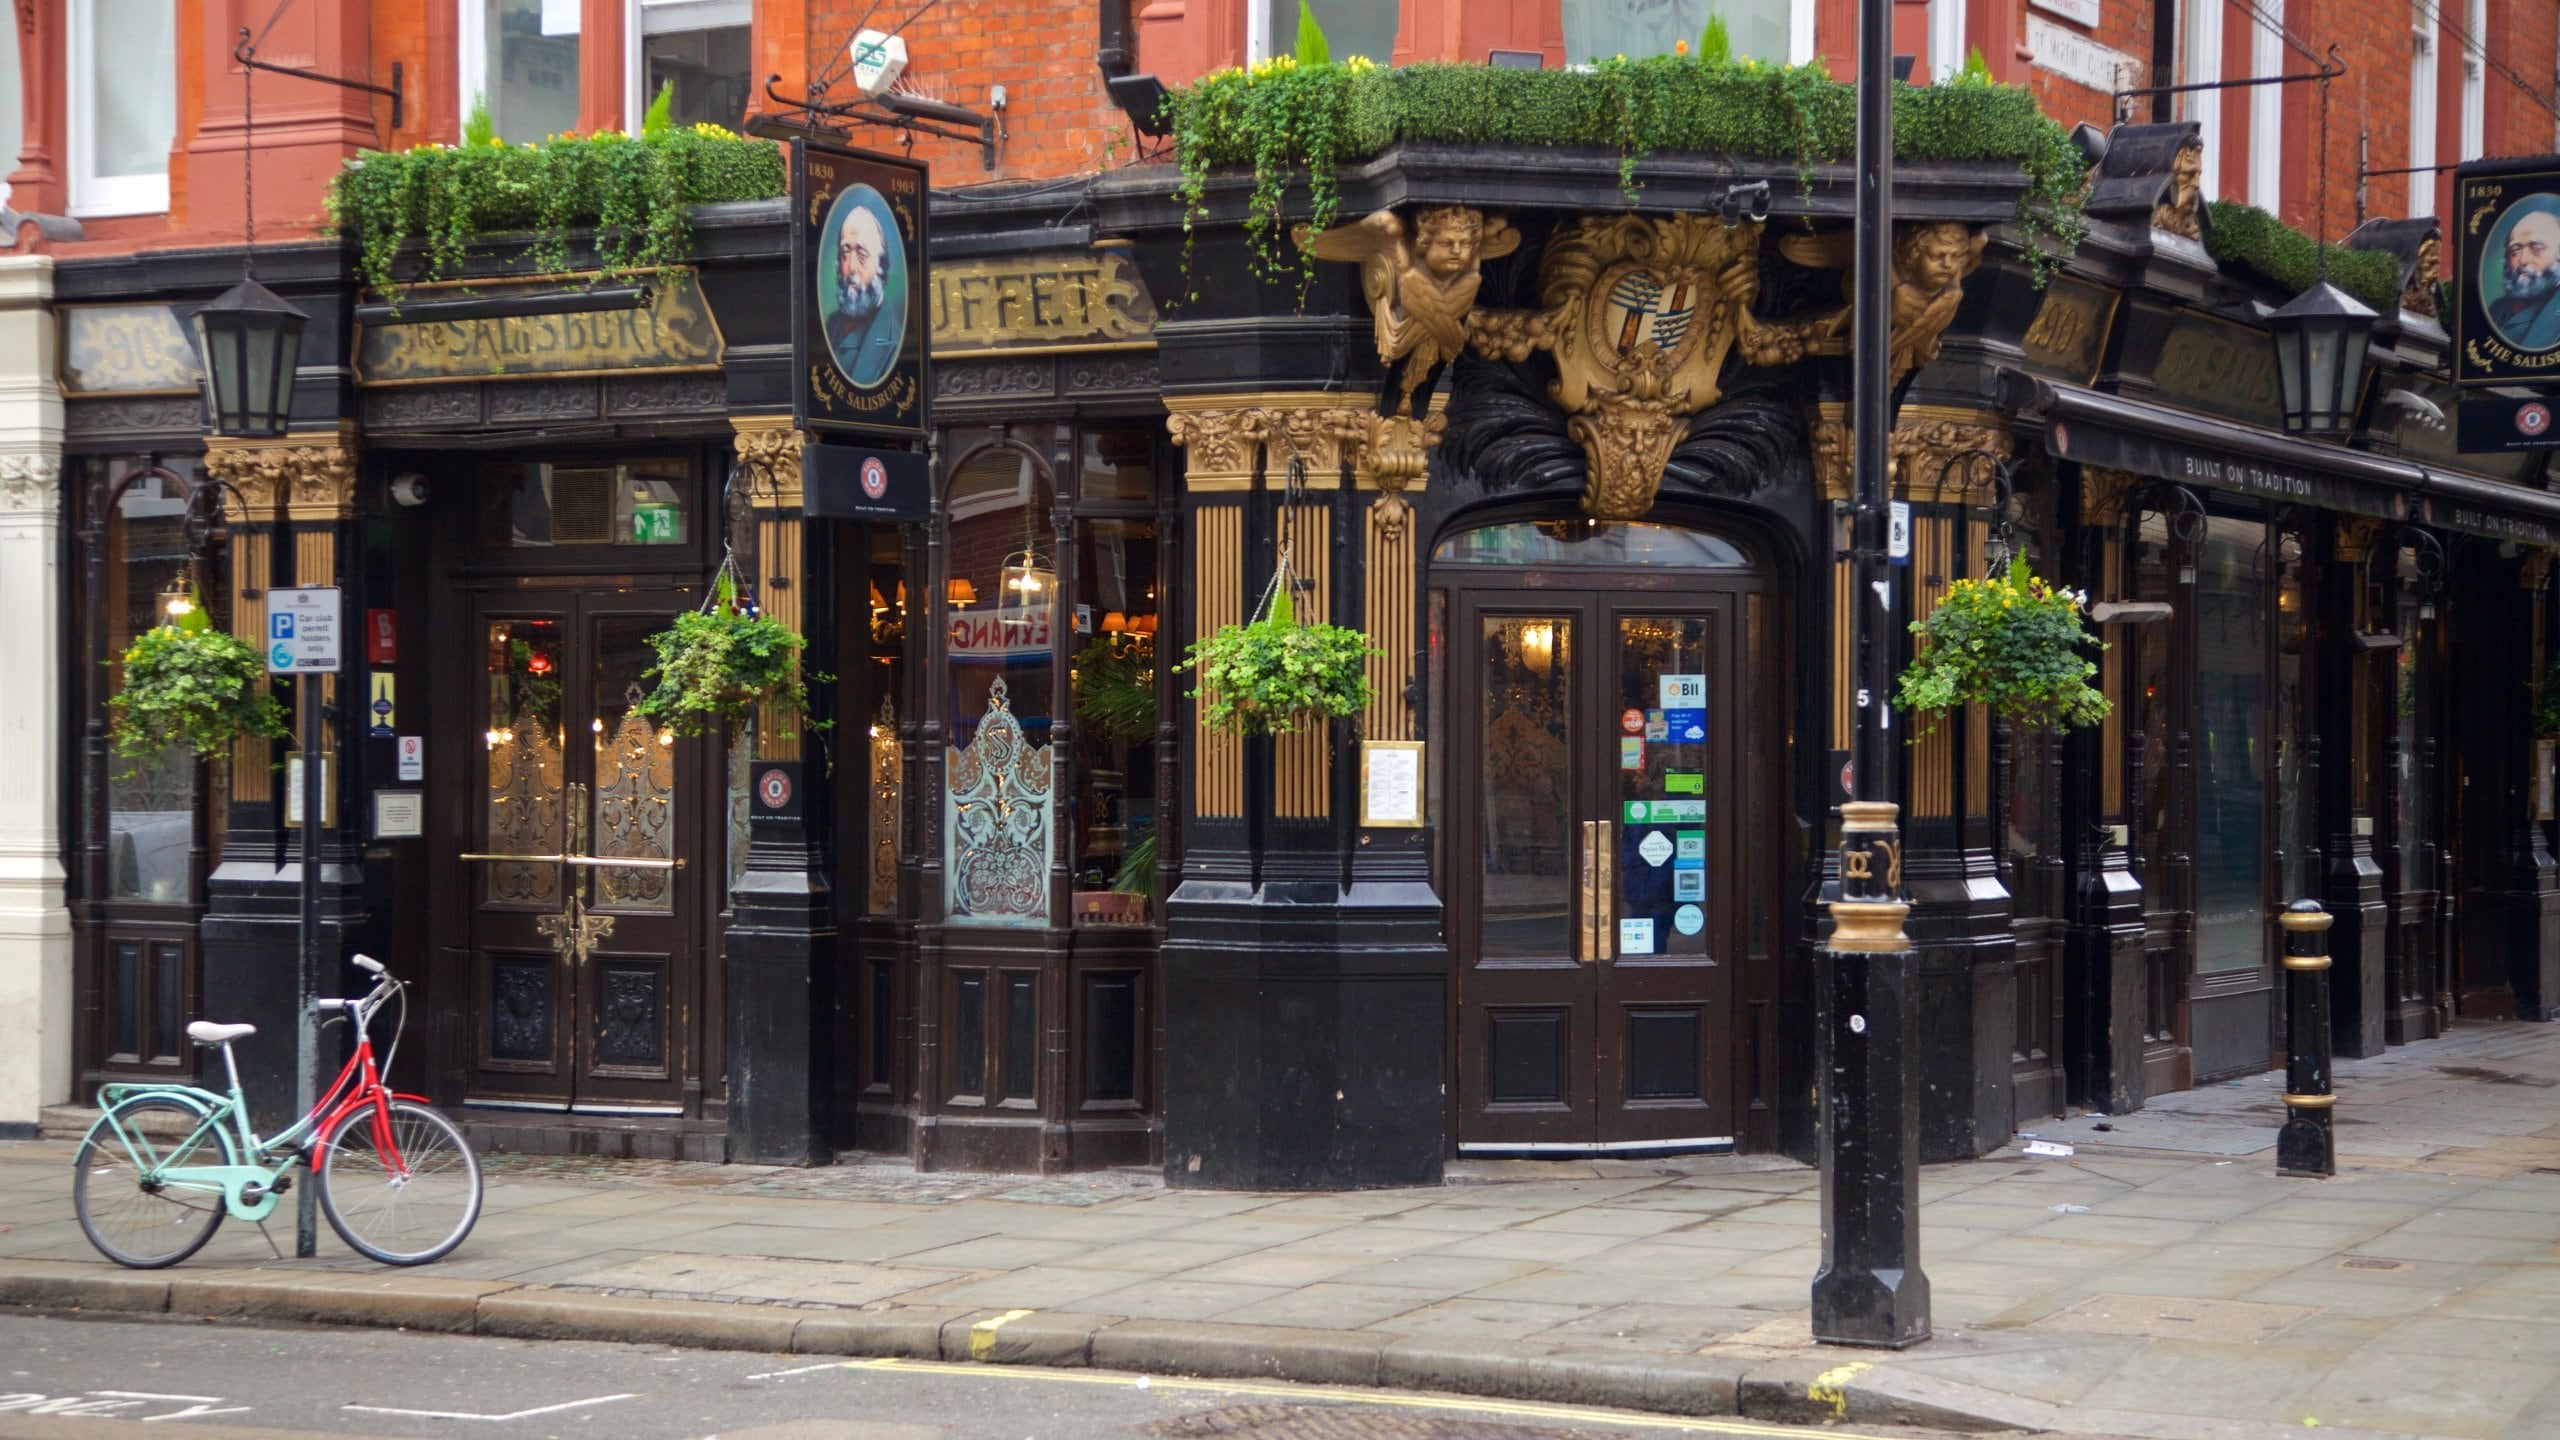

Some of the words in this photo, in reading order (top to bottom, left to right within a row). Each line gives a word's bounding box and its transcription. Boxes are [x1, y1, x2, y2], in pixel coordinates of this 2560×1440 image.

[808, 163, 834, 179] 1830
[891, 178, 915, 193] 1903
[2470, 185, 2502, 198] 1830
[929, 269, 1101, 332] UFFET
[2483, 336, 2512, 362] THE
[2513, 349, 2560, 368] SALIS
[824, 363, 846, 399] THE
[848, 371, 905, 411] SALISBURY
[2186, 457, 2220, 478] BUILT
[2227, 465, 2244, 483] ON
[2250, 469, 2311, 496] TRADITION
[2455, 508, 2482, 529] BUILT
[299, 614, 312, 622] Car
[315, 614, 333, 622] club
[307, 645, 324, 653] only
[1857, 690, 1869, 707] 5
